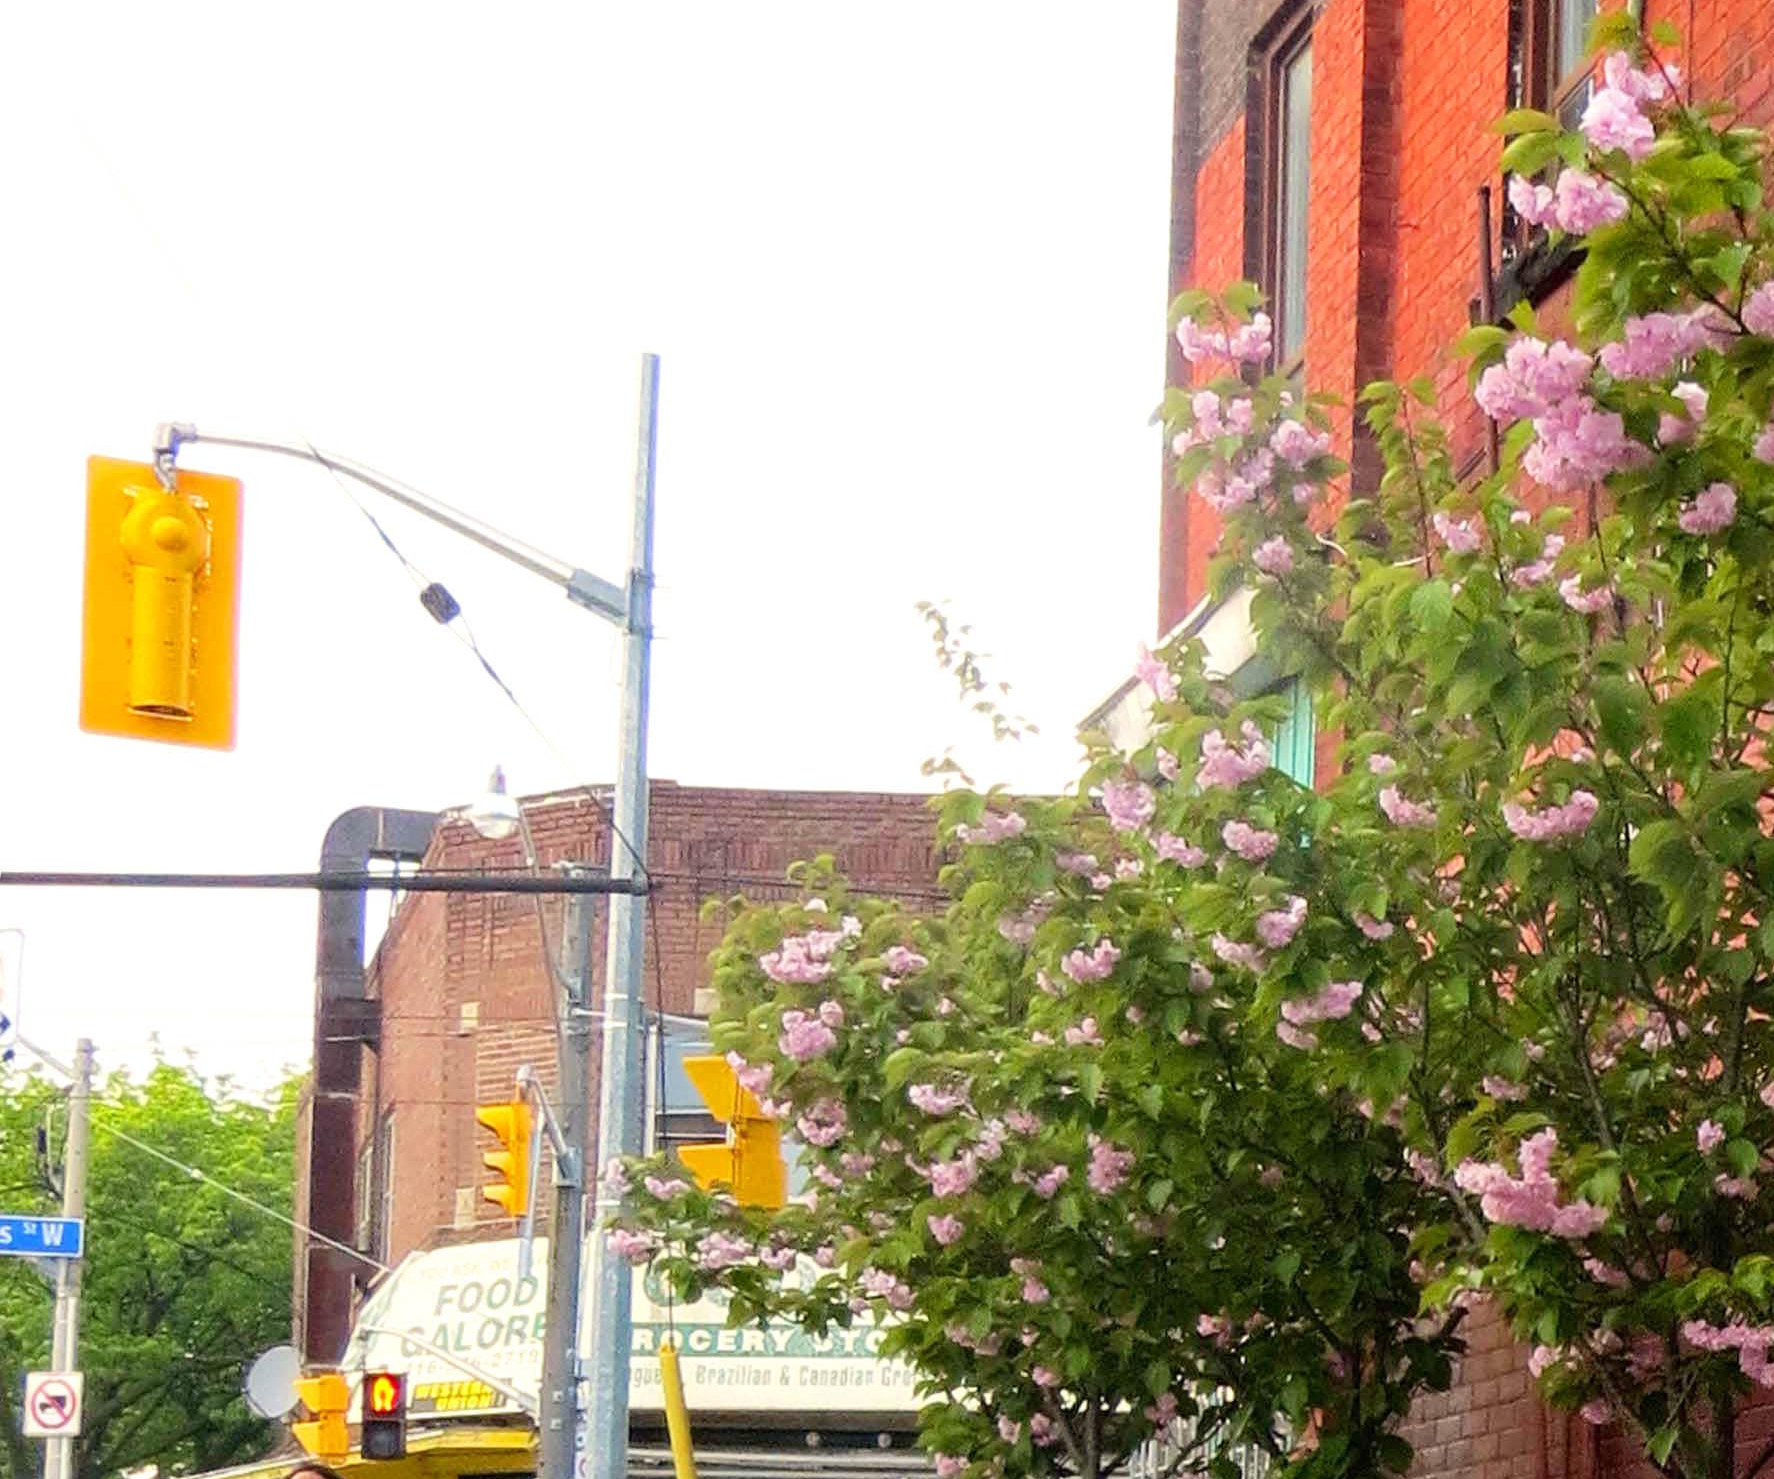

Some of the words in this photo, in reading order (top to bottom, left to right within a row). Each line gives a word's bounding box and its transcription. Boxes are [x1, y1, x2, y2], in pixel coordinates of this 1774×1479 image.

[42, 1222, 64, 1246] W
[433, 1276, 539, 1316] FOOD
[401, 1312, 547, 1358] GALORE
[631, 1328, 790, 1352] ROCERY
[695, 1364, 773, 1387] Brazilian
[779, 1365, 791, 1387] &
[799, 1365, 876, 1387] Canadian
